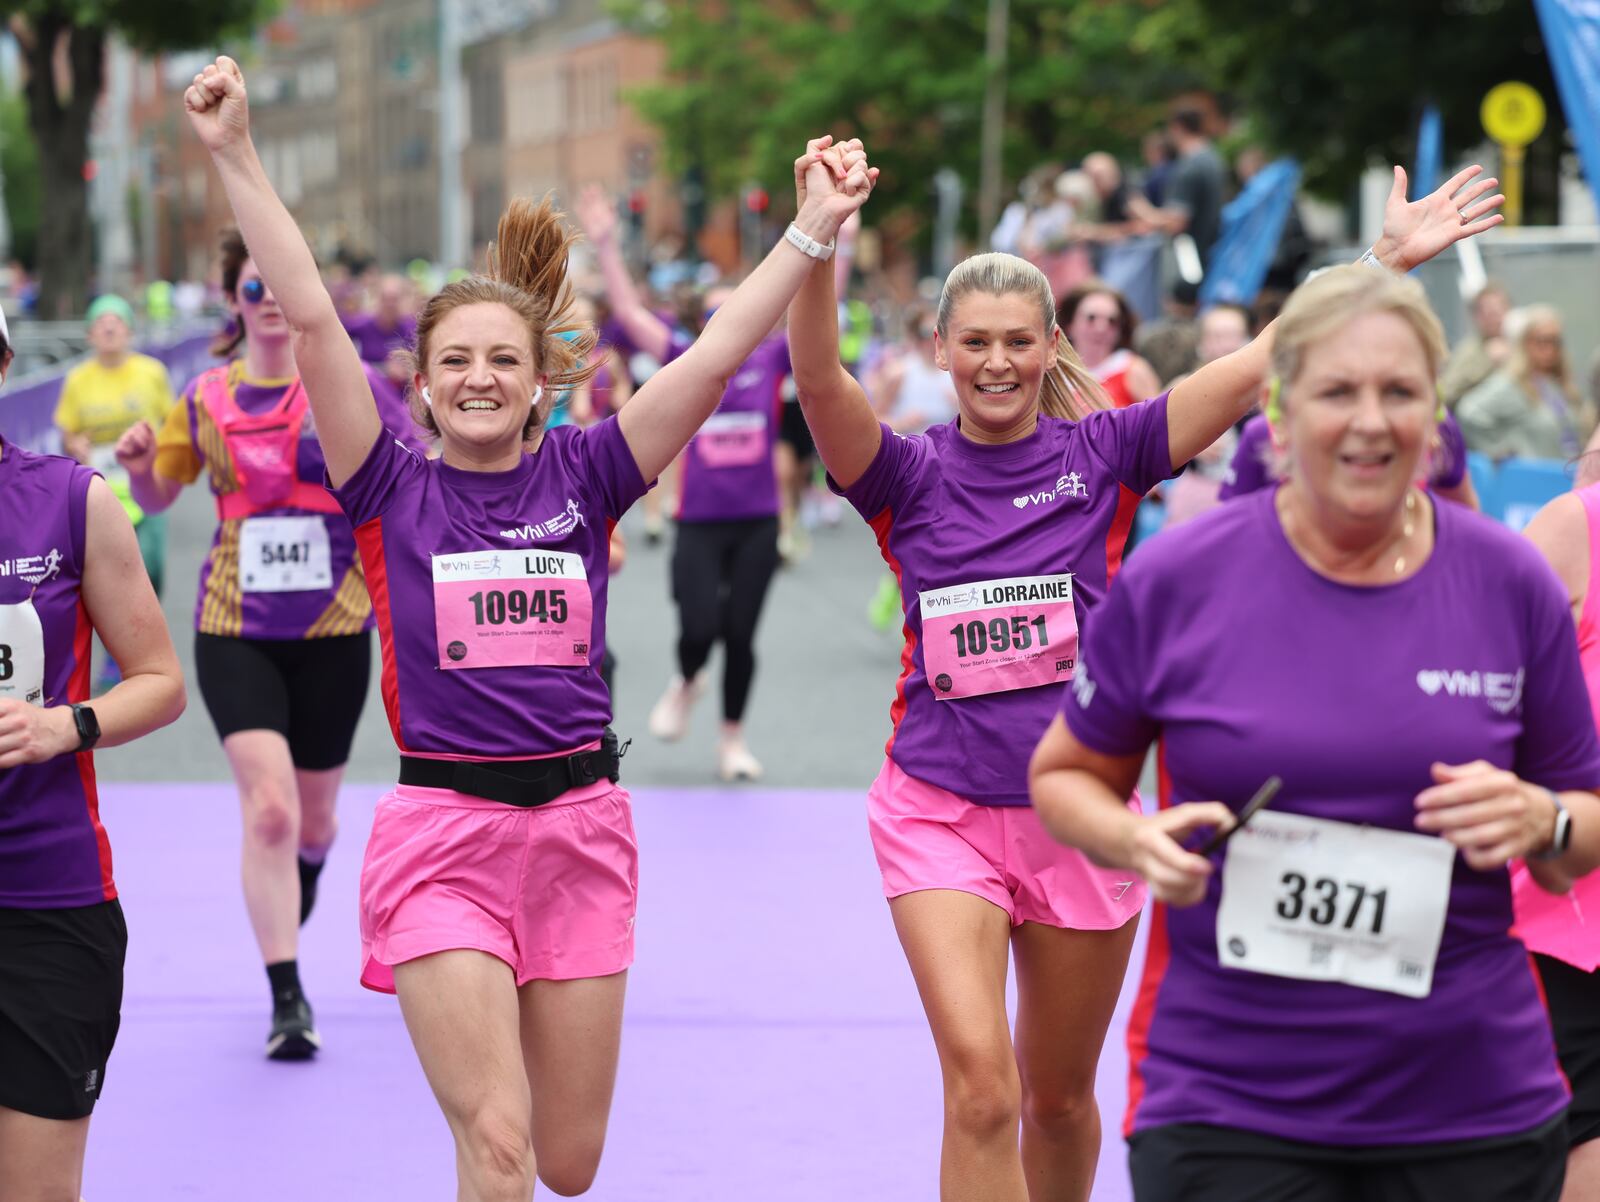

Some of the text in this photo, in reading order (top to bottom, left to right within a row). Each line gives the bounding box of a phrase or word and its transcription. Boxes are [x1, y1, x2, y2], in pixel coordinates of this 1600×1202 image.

[1029, 489, 1056, 505] Vhi
[515, 524, 546, 540] Vhi
[452, 560, 471, 571] Vhi
[525, 556, 565, 575] LUCY
[936, 596, 951, 607] Vhi
[983, 582, 1068, 604] LORRAINE
[468, 590, 568, 625] 10945
[951, 614, 1049, 657] 10951
[1276, 870, 1388, 935] 3371
